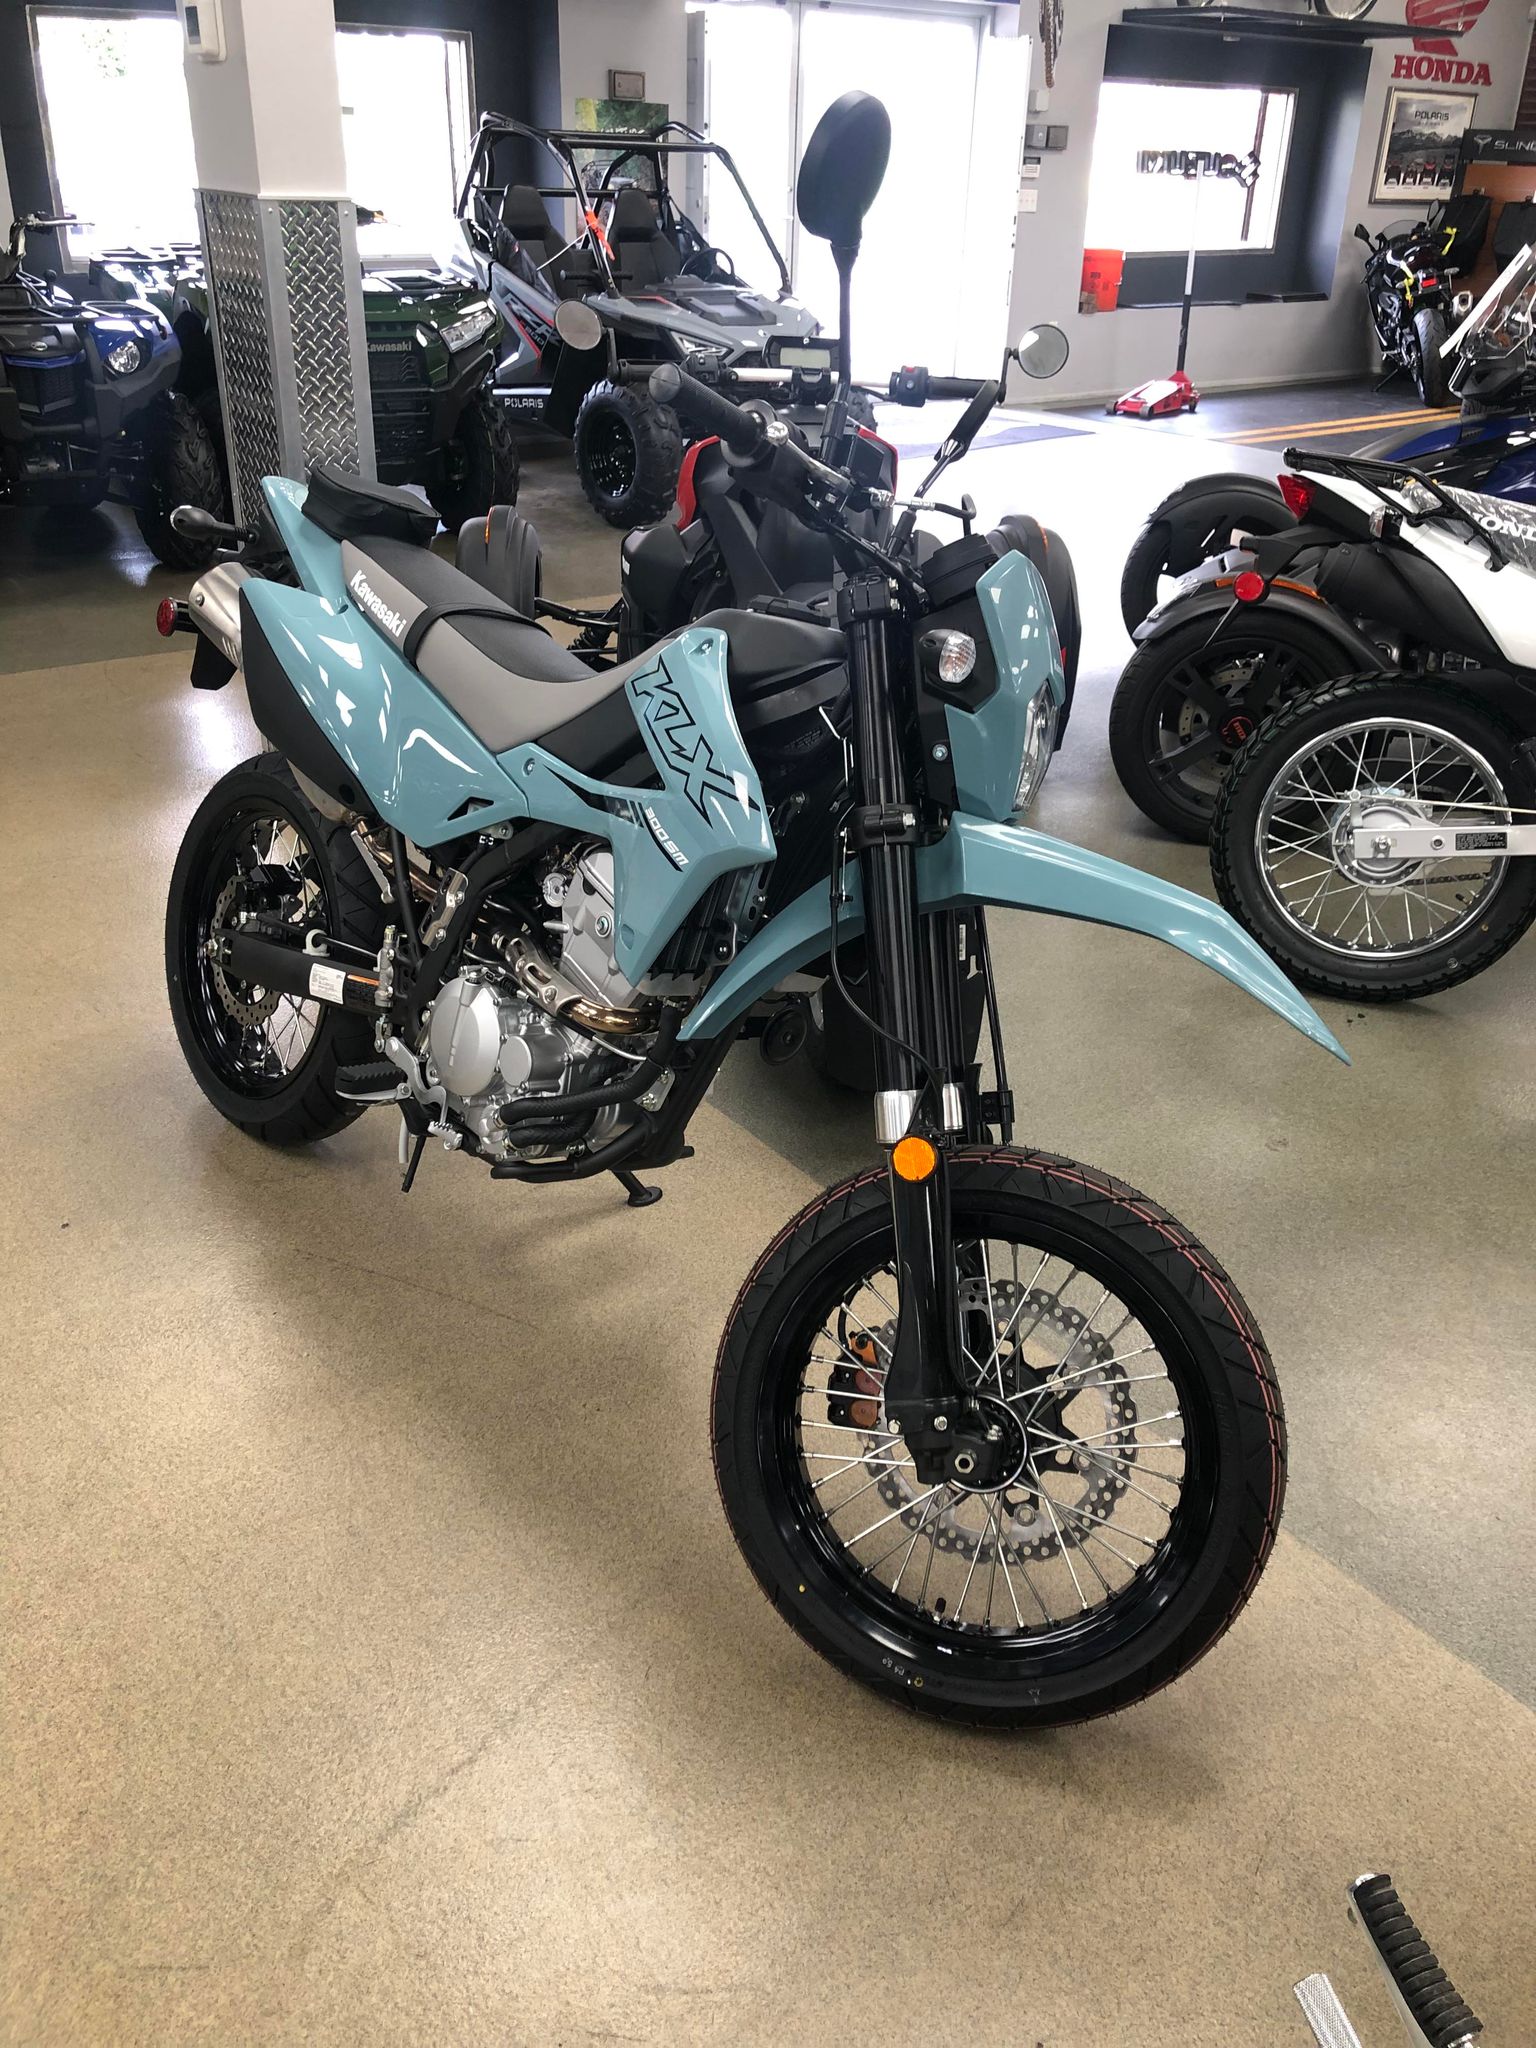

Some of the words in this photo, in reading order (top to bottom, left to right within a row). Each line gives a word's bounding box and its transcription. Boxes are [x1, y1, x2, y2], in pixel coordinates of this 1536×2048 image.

[1391, 54, 1492, 86] HONDA
[1414, 110, 1450, 121] POLARIS
[504, 397, 544, 409] POLARIS
[350, 569, 407, 638] Kawasaki
[631, 654, 761, 829] KLX
